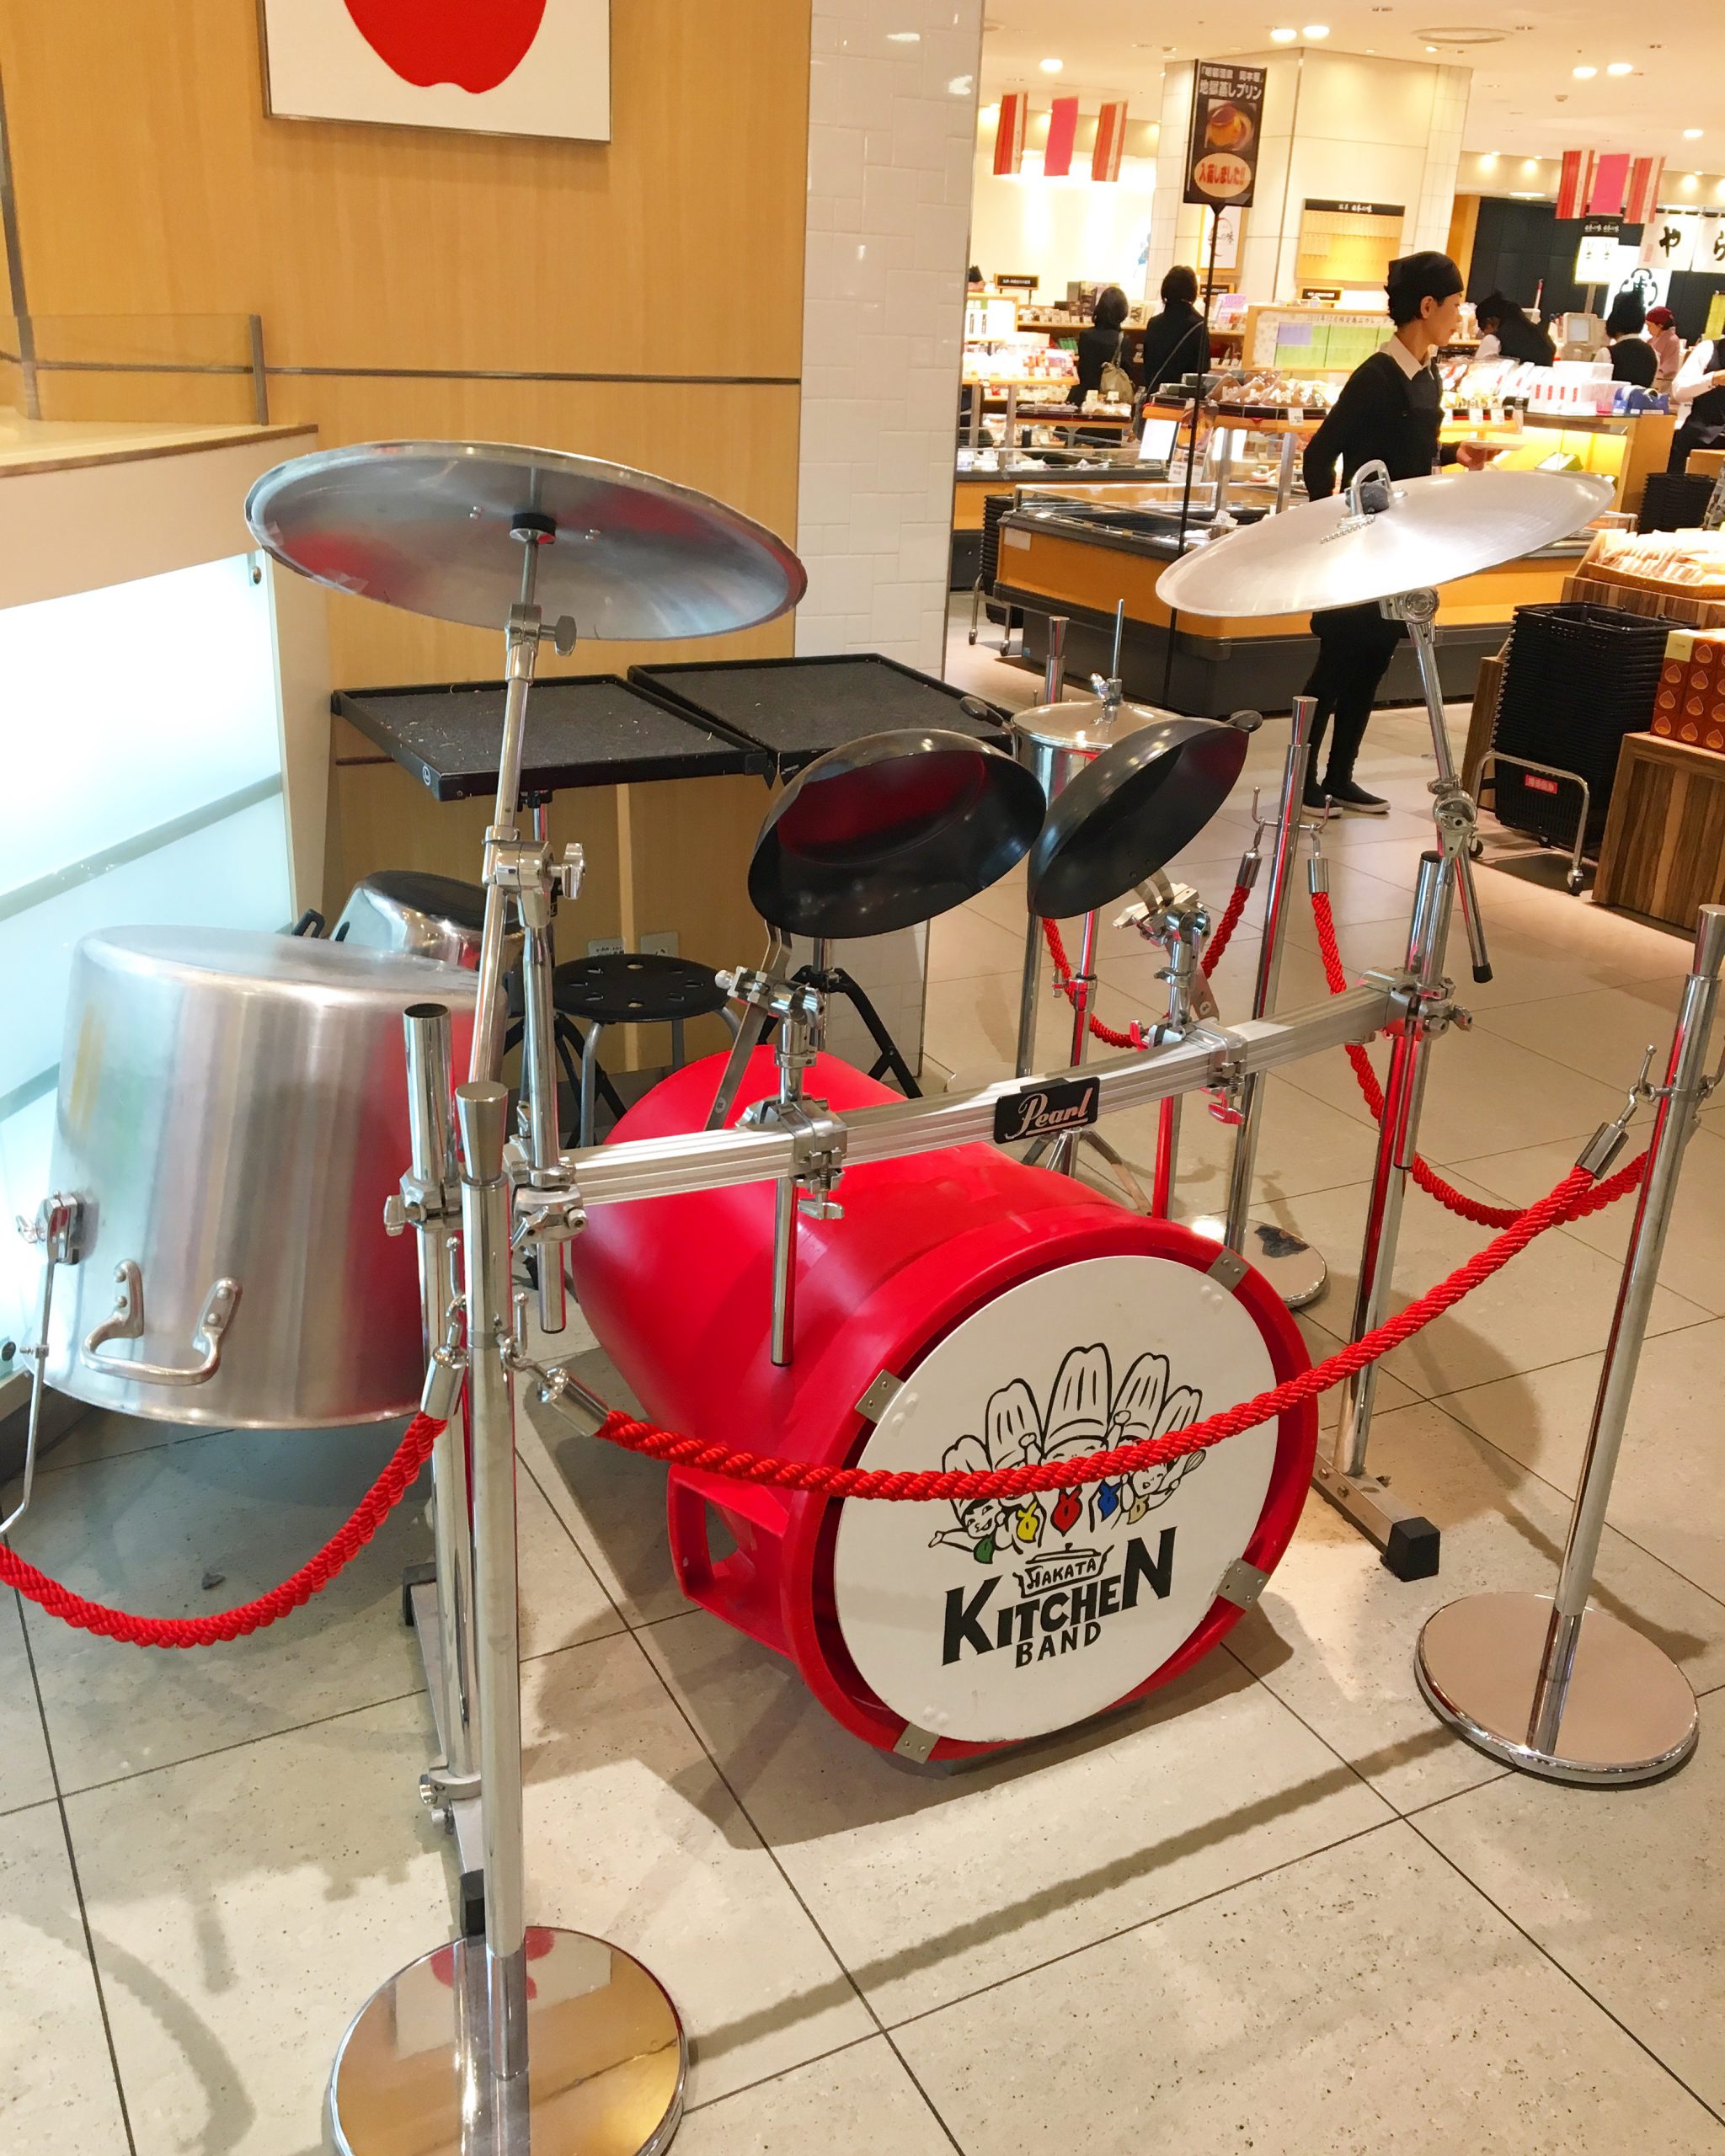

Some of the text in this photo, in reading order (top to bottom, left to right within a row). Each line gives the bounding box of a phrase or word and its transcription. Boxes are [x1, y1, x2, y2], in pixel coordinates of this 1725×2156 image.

[1659, 226, 1681, 258] や
[1005, 1087, 1093, 1139] Pearl
[943, 1526, 1177, 1666] KITCHEN
[1025, 1558, 1096, 1589] HAKATA
[1015, 1621, 1102, 1668] BAND
